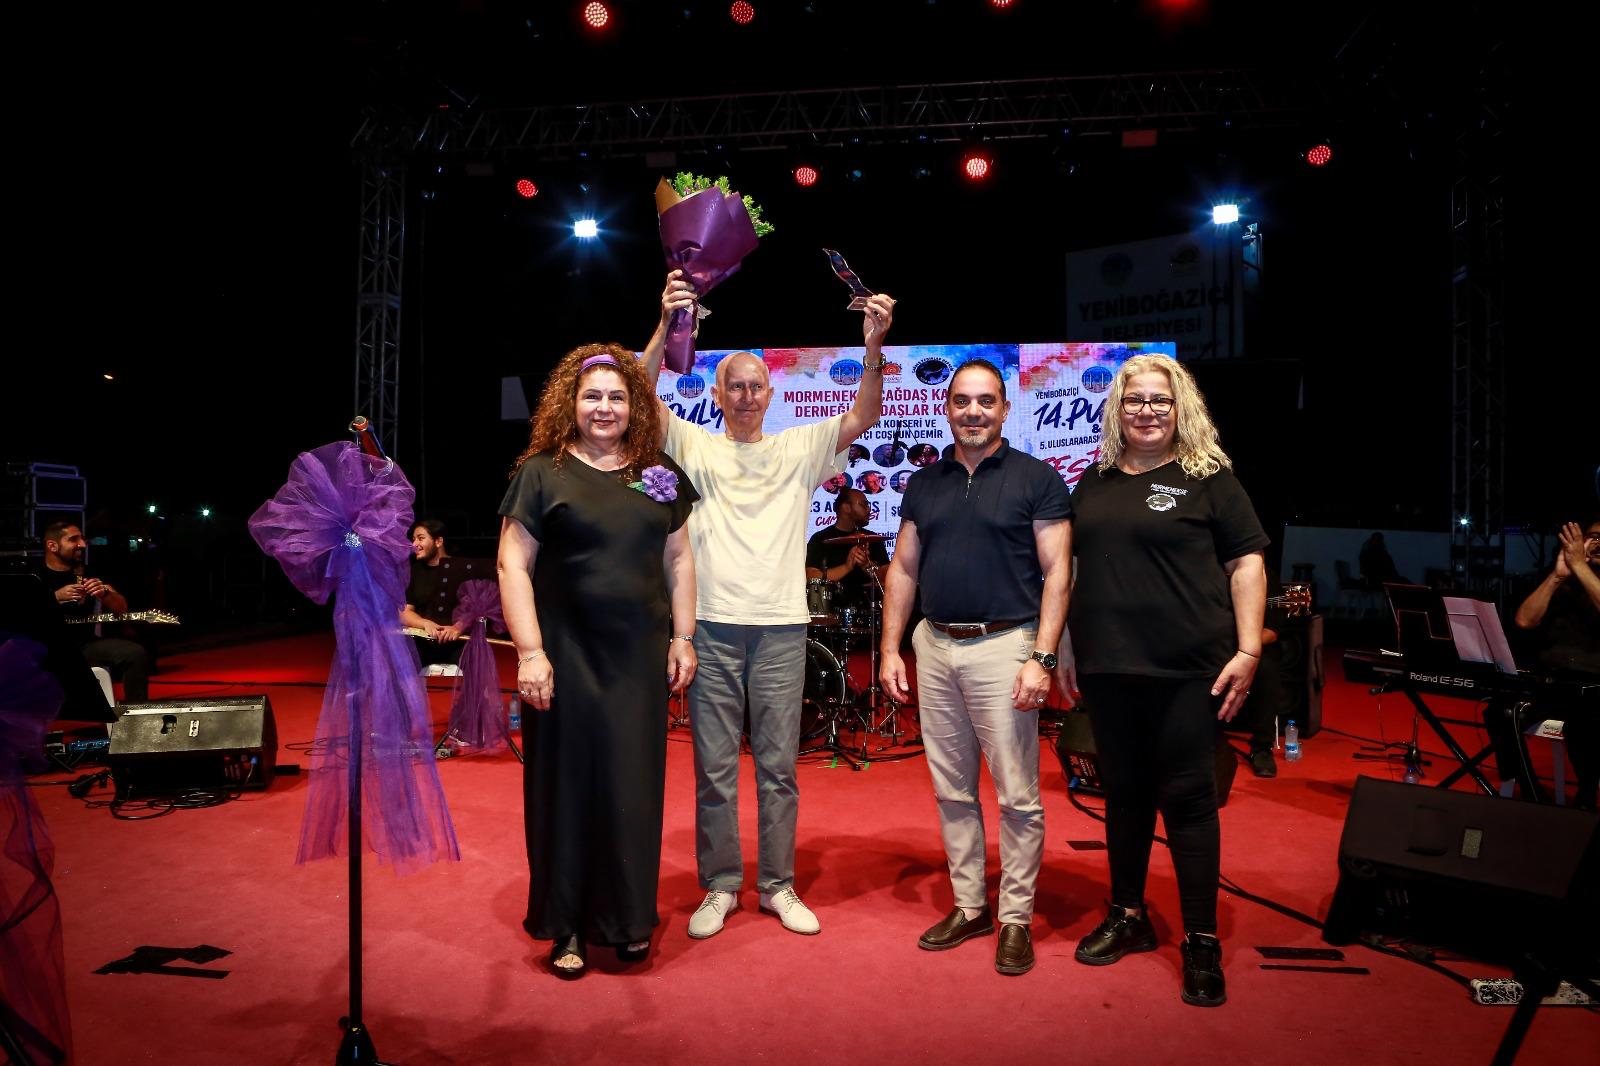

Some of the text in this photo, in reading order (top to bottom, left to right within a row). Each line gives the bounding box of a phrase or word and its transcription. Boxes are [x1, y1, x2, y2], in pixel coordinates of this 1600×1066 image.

[1079, 283, 1233, 321] YENİBOĞAZİÇİ
[1104, 313, 1201, 340] BELEDİYESİ
[784, 390, 858, 403] MORMENEK
[931, 389, 948, 400] KA
[1035, 386, 1079, 400] YENİBOĞAZİÇİ
[795, 402, 850, 417] DERNEĞİ
[880, 404, 931, 419] DAŞLAR
[1033, 397, 1106, 431] 14.PU
[925, 419, 937, 428] VE
[914, 429, 943, 439] DEMİR
[1410, 672, 1438, 684] Roland
